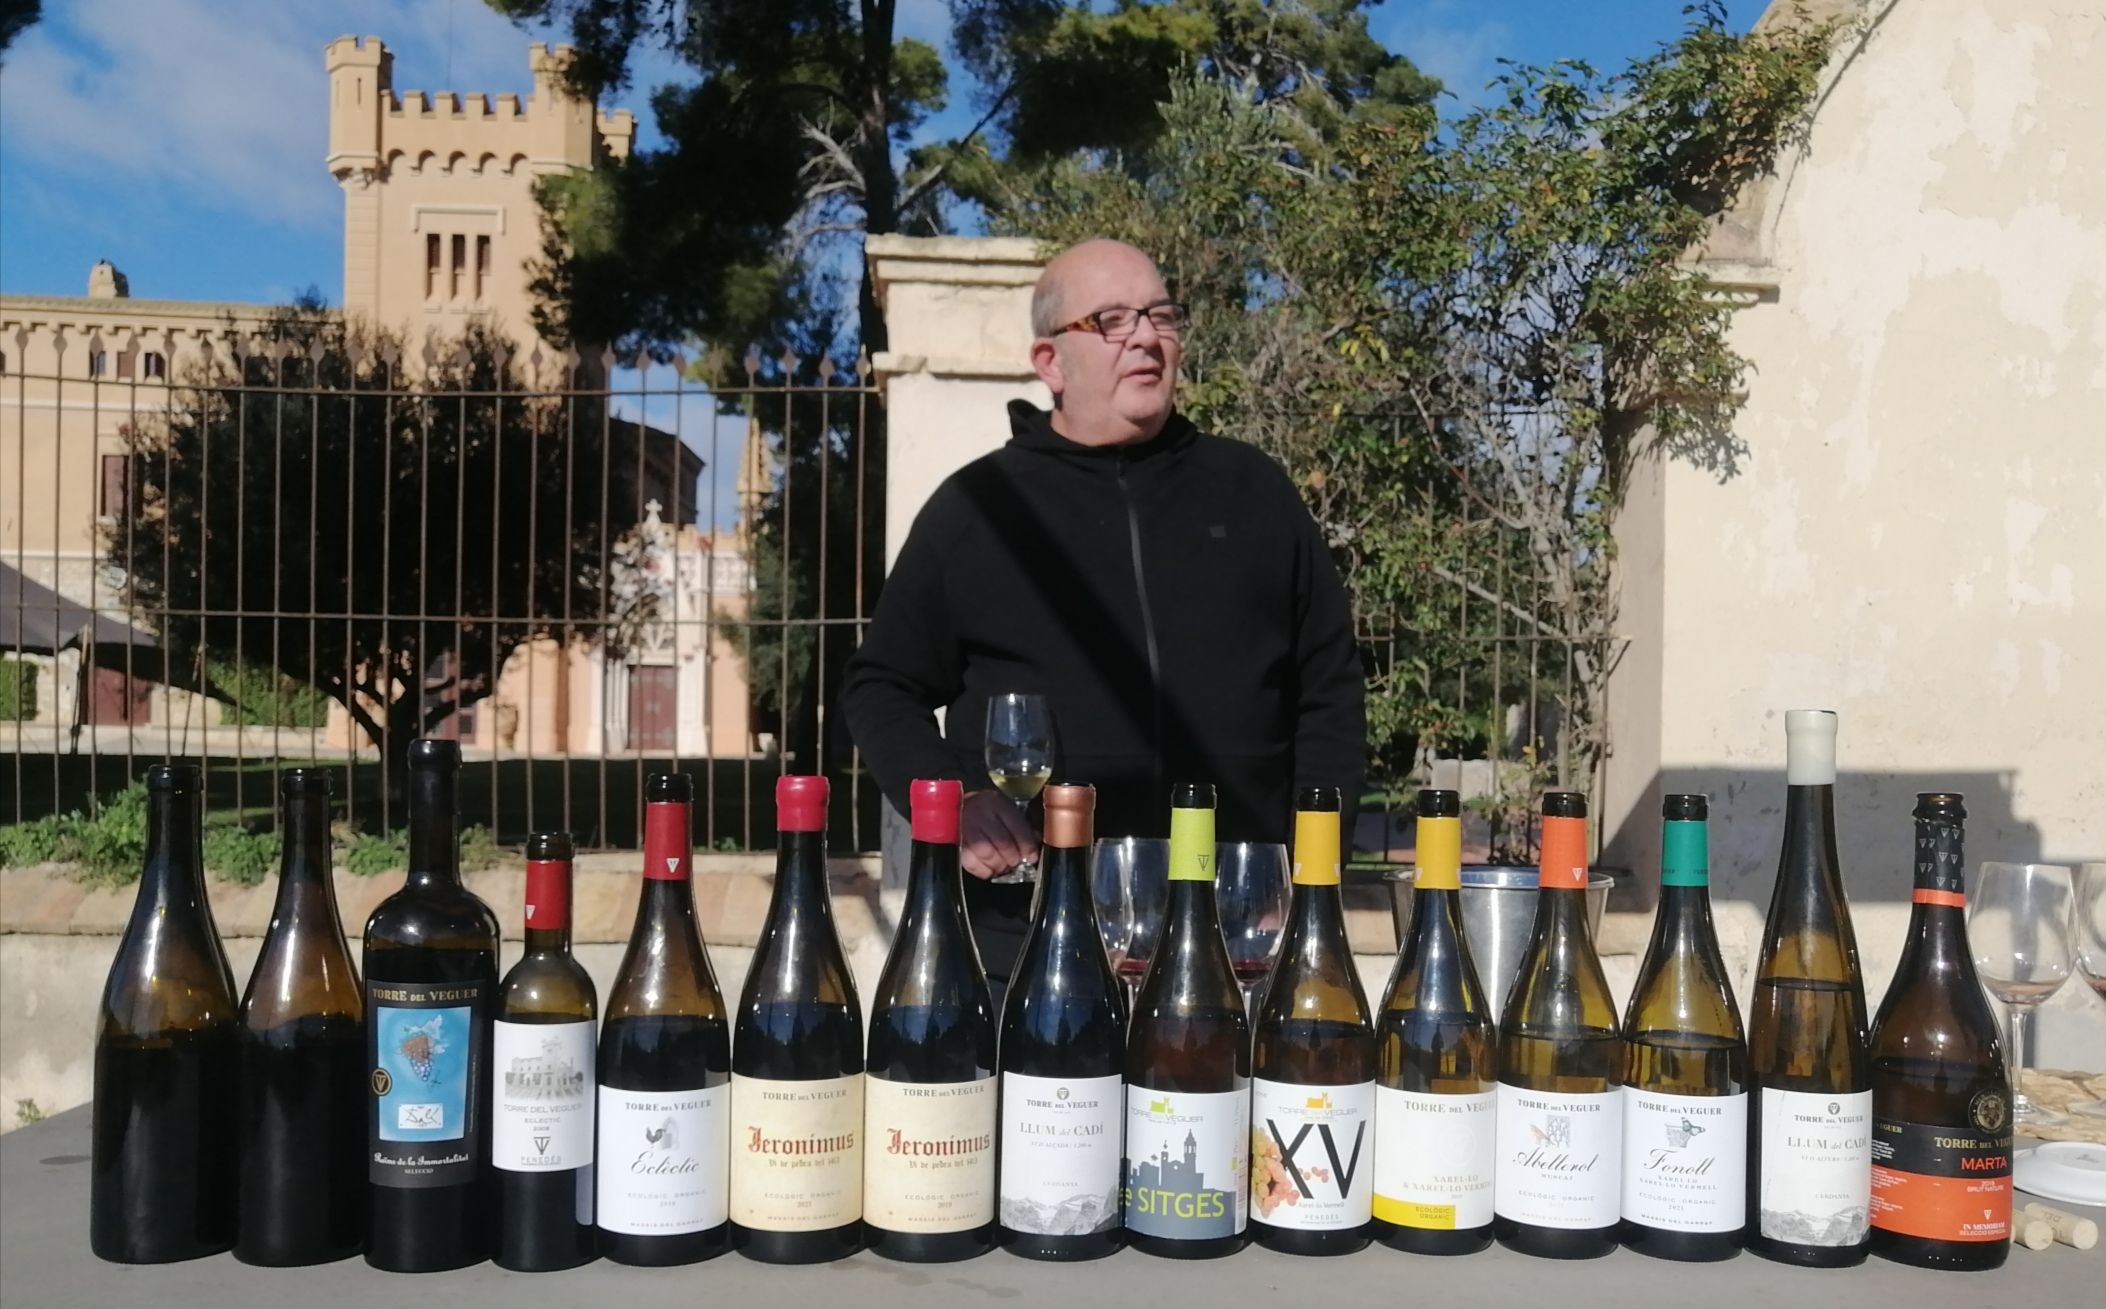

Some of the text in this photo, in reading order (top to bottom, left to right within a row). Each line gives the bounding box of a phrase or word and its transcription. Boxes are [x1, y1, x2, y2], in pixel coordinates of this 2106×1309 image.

[373, 988, 407, 1001] TORRE
[430, 988, 478, 1001] VEGUER
[762, 1092, 797, 1100] TORRE
[810, 1090, 847, 1100] VEGUER
[903, 1089, 937, 1097] TORRE
[951, 1086, 985, 1096] VEGUER
[625, 1102, 659, 1111] TORRE
[674, 1100, 712, 1111] VEGUER
[1026, 1099, 1053, 1108] TORRE
[1404, 1100, 1446, 1112] TORRE
[1517, 1099, 1549, 1110] TORRE
[1563, 1104, 1601, 1112] VEGUER
[1638, 1101, 1669, 1112] TORRE
[1682, 1107, 1722, 1115] VEGUER
[1794, 1114, 1824, 1123] TORRE
[1838, 1115, 1864, 1123] VEGUER
[1020, 1122, 1056, 1135] LLUM
[748, 1126, 854, 1155] Jeronimus
[887, 1128, 991, 1157] Jeronimus
[1787, 1136, 1828, 1149] LLUM
[1934, 1136, 1977, 1149] TORRE
[1979, 1141, 1993, 1149] DEL
[1265, 1118, 1367, 1200] XV
[1643, 1148, 1716, 1176] Fonoll
[1960, 1156, 2008, 1171] MARTA
[1137, 1186, 1225, 1219] SITGES
